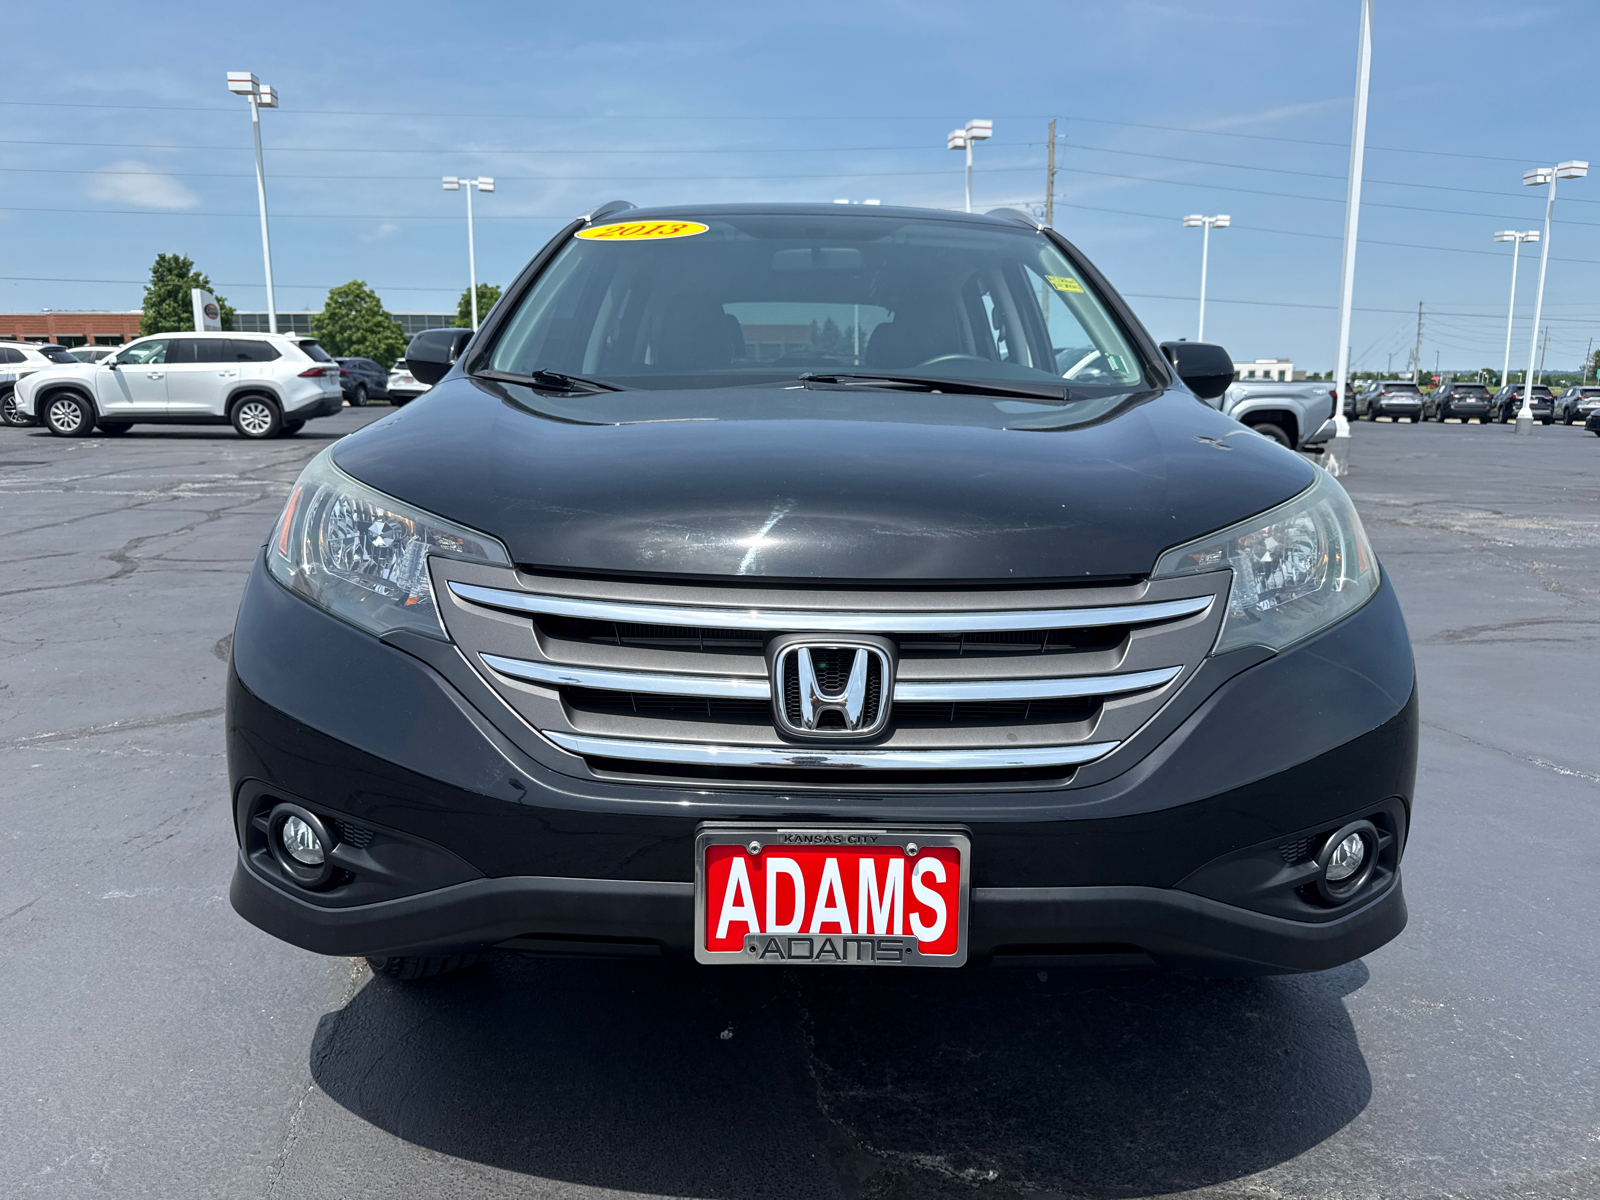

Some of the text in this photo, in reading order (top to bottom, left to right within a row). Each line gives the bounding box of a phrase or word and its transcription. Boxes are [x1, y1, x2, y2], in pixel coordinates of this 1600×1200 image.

[593, 224, 688, 238] 2013
[784, 834, 879, 845] KANSAS CITY
[715, 856, 948, 943] ADAMS
[758, 937, 904, 962] ADAMS
